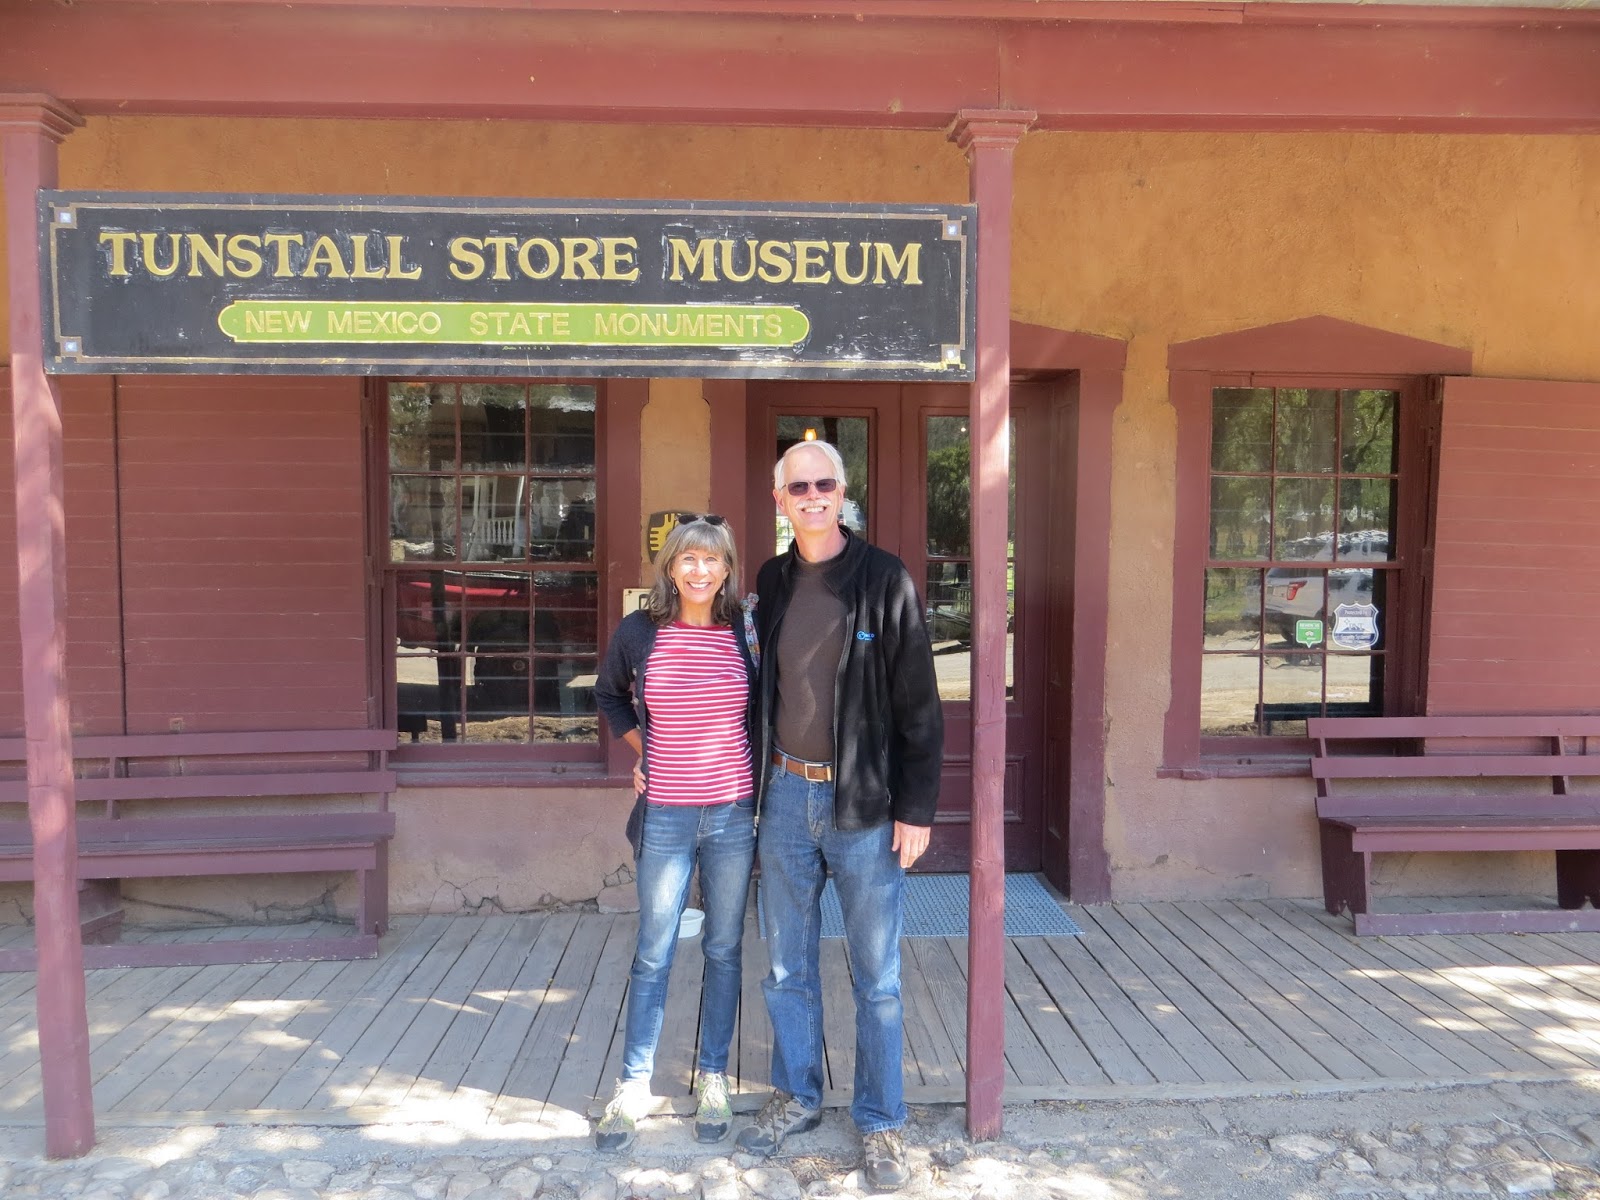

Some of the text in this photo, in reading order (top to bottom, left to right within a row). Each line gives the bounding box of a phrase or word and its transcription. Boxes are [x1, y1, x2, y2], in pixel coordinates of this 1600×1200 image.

[99, 232, 923, 286] TUNSTALL STORE MUSEUM
[244, 310, 783, 338] NEW MEXICO STATE MONUMENTS
